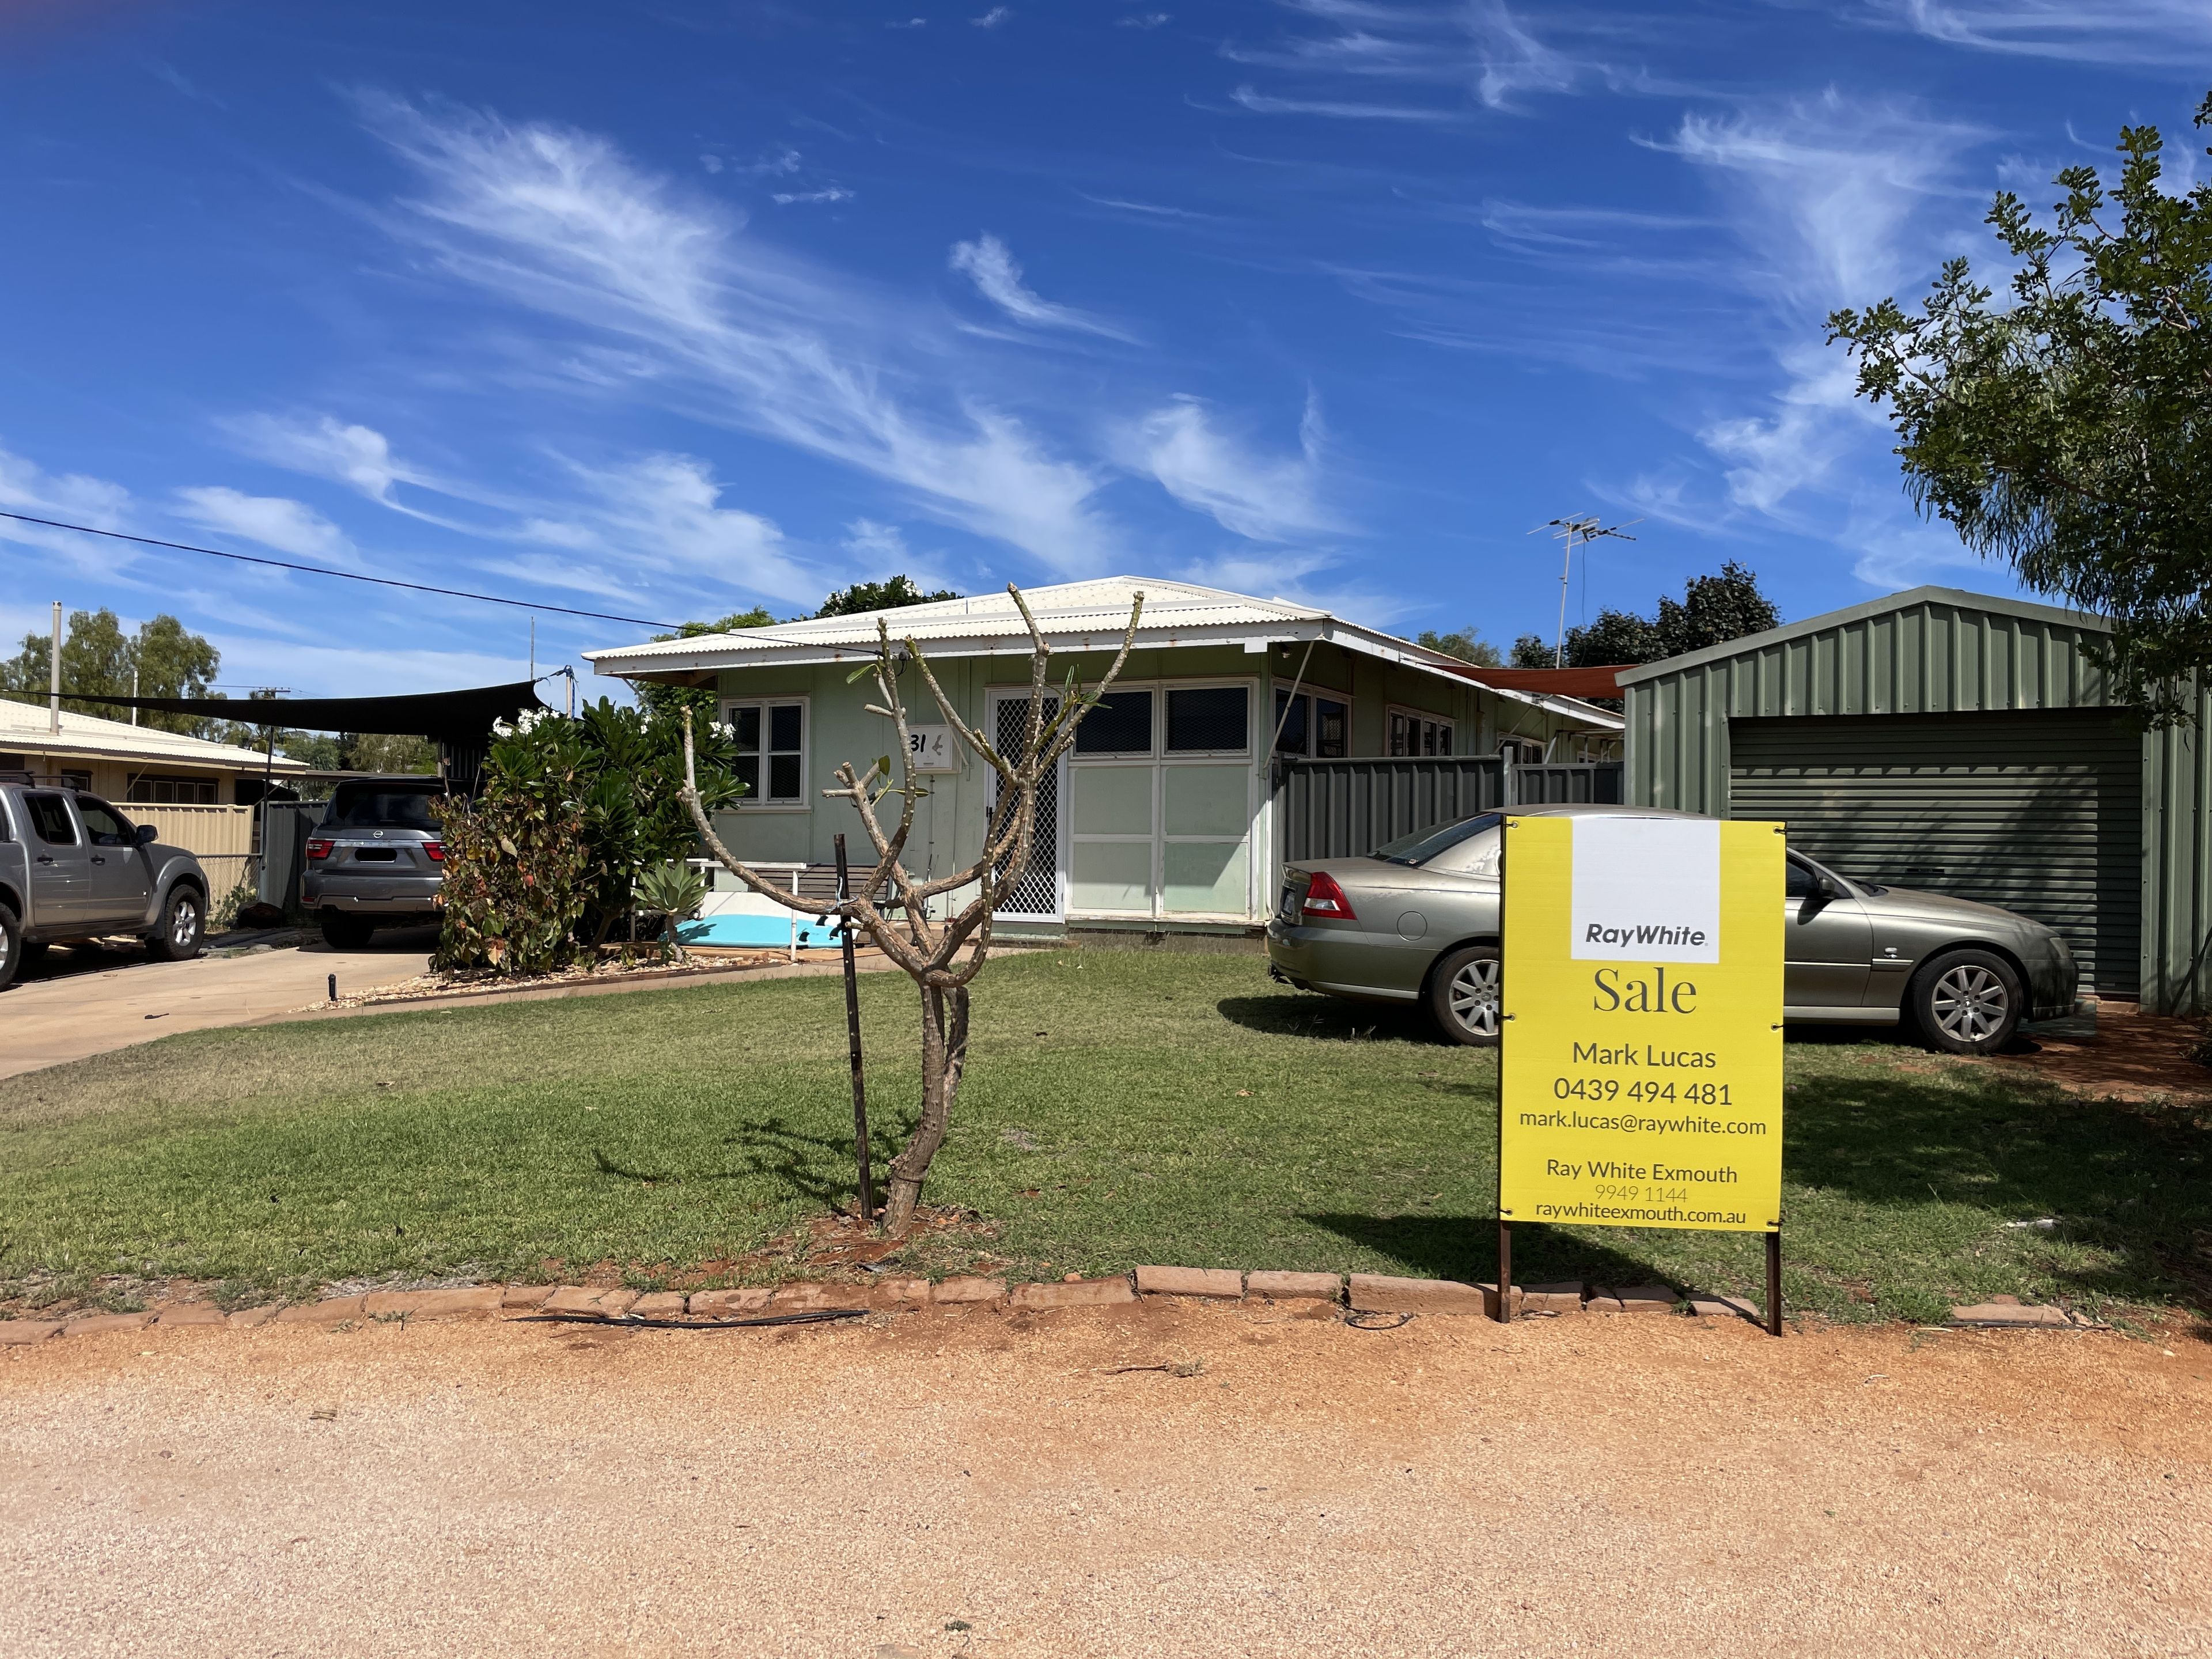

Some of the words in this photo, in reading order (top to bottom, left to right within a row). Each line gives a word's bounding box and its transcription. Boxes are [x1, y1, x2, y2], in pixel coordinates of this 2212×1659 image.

[1594, 967, 1696, 1014] Sale
[1573, 1041, 1639, 1066] Mark
[1647, 1044, 1717, 1068] Lucas
[1554, 1078, 1619, 1101] 0439
[1627, 1081, 1677, 1104] 494
[1684, 1083, 1732, 1105] 481
[1520, 1110, 1766, 1135] mark.lucas@raywhite.com
[1547, 1159, 1582, 1180] Ray
[1588, 1161, 1646, 1180] White
[1653, 1164, 1737, 1183] Exmouth
[1595, 1184, 1639, 1201] 9949
[1645, 1187, 1689, 1203] 1144
[1536, 1202, 1747, 1224] raywhiteexmouth.com.au
